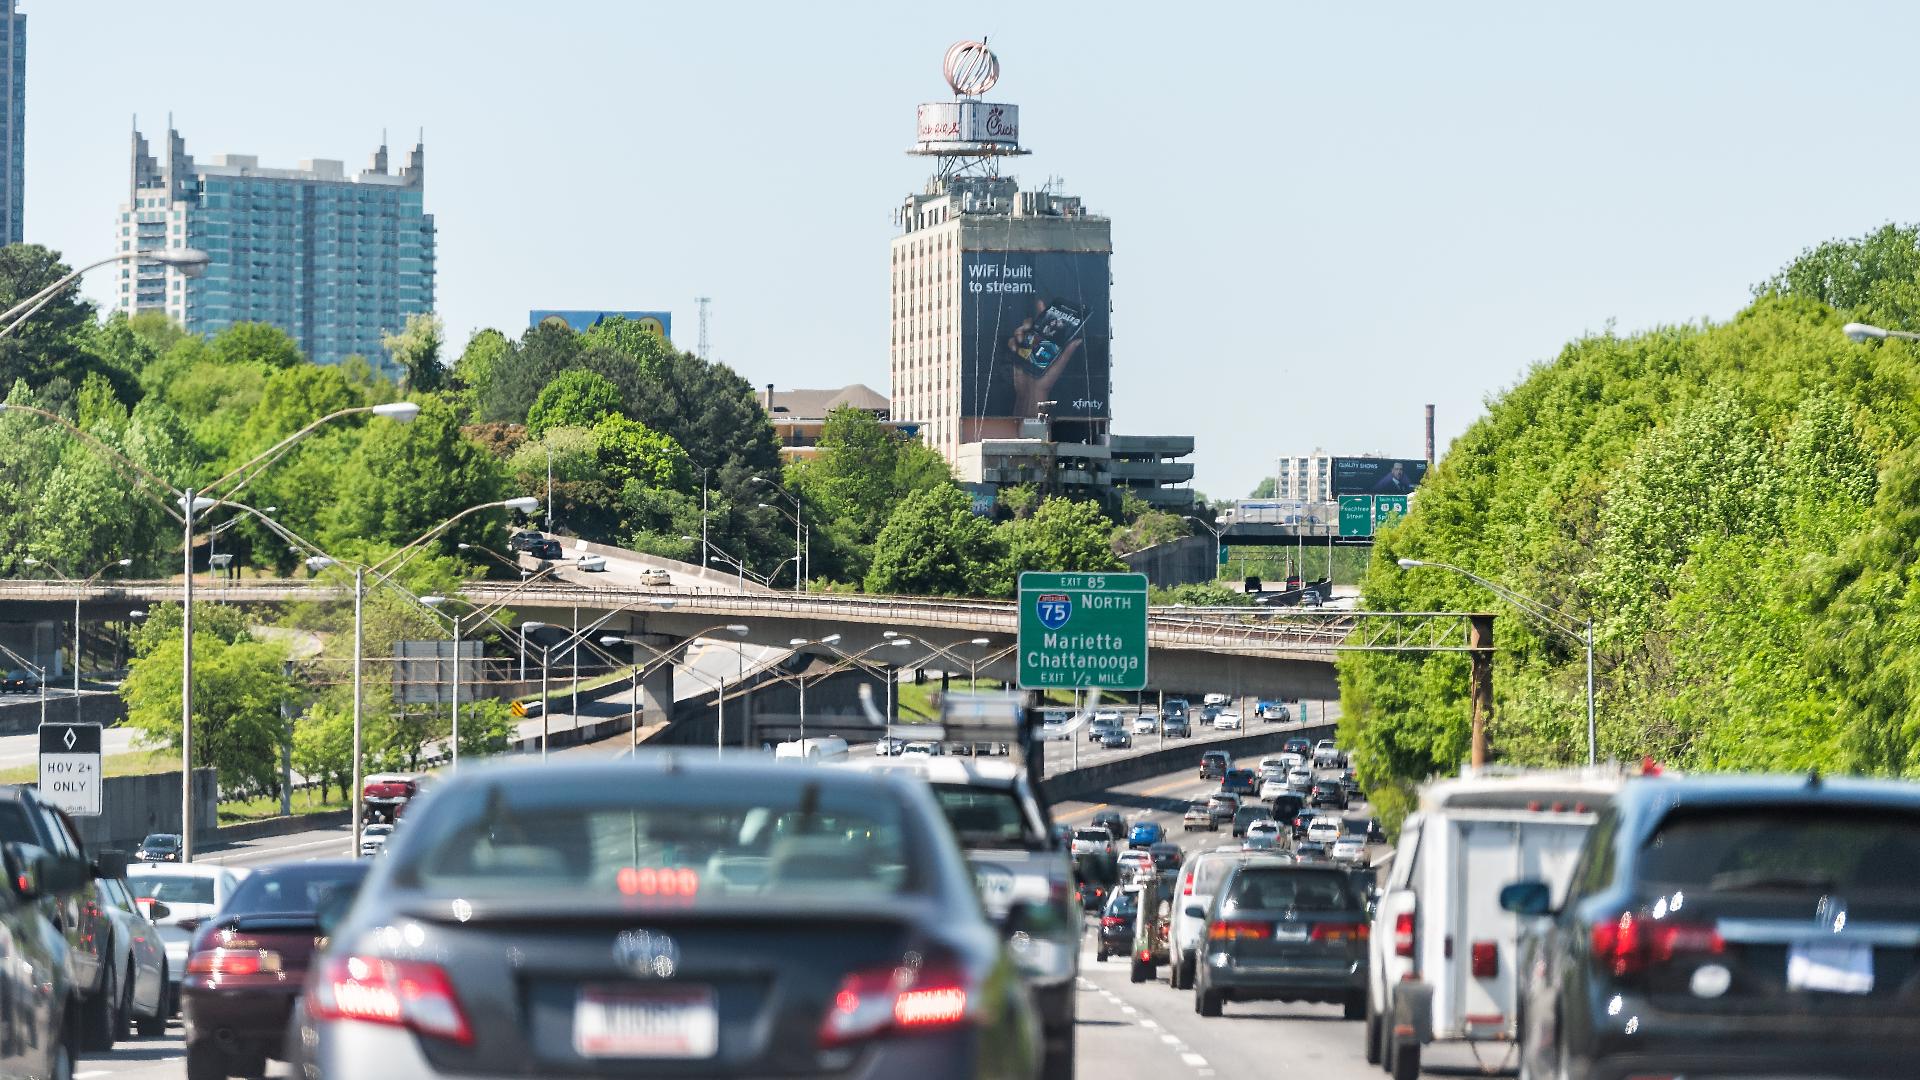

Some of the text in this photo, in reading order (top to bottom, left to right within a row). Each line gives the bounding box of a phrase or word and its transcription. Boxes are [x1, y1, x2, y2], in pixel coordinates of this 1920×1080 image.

[969, 264, 1033, 278] WiFi built
[969, 281, 1036, 293] to stream.
[1072, 398, 1103, 410] xfinity
[1061, 577, 1105, 589] EXIT 85
[1042, 594, 1131, 621] 75 NORTH
[1044, 633, 1122, 650] Marietta
[1027, 652, 1138, 674] Chattanooga
[1041, 673, 1064, 683] EXIT
[1098, 673, 1125, 684] MILE
[48, 762, 92, 773] HOV 2+
[53, 781, 86, 792] ONLY
